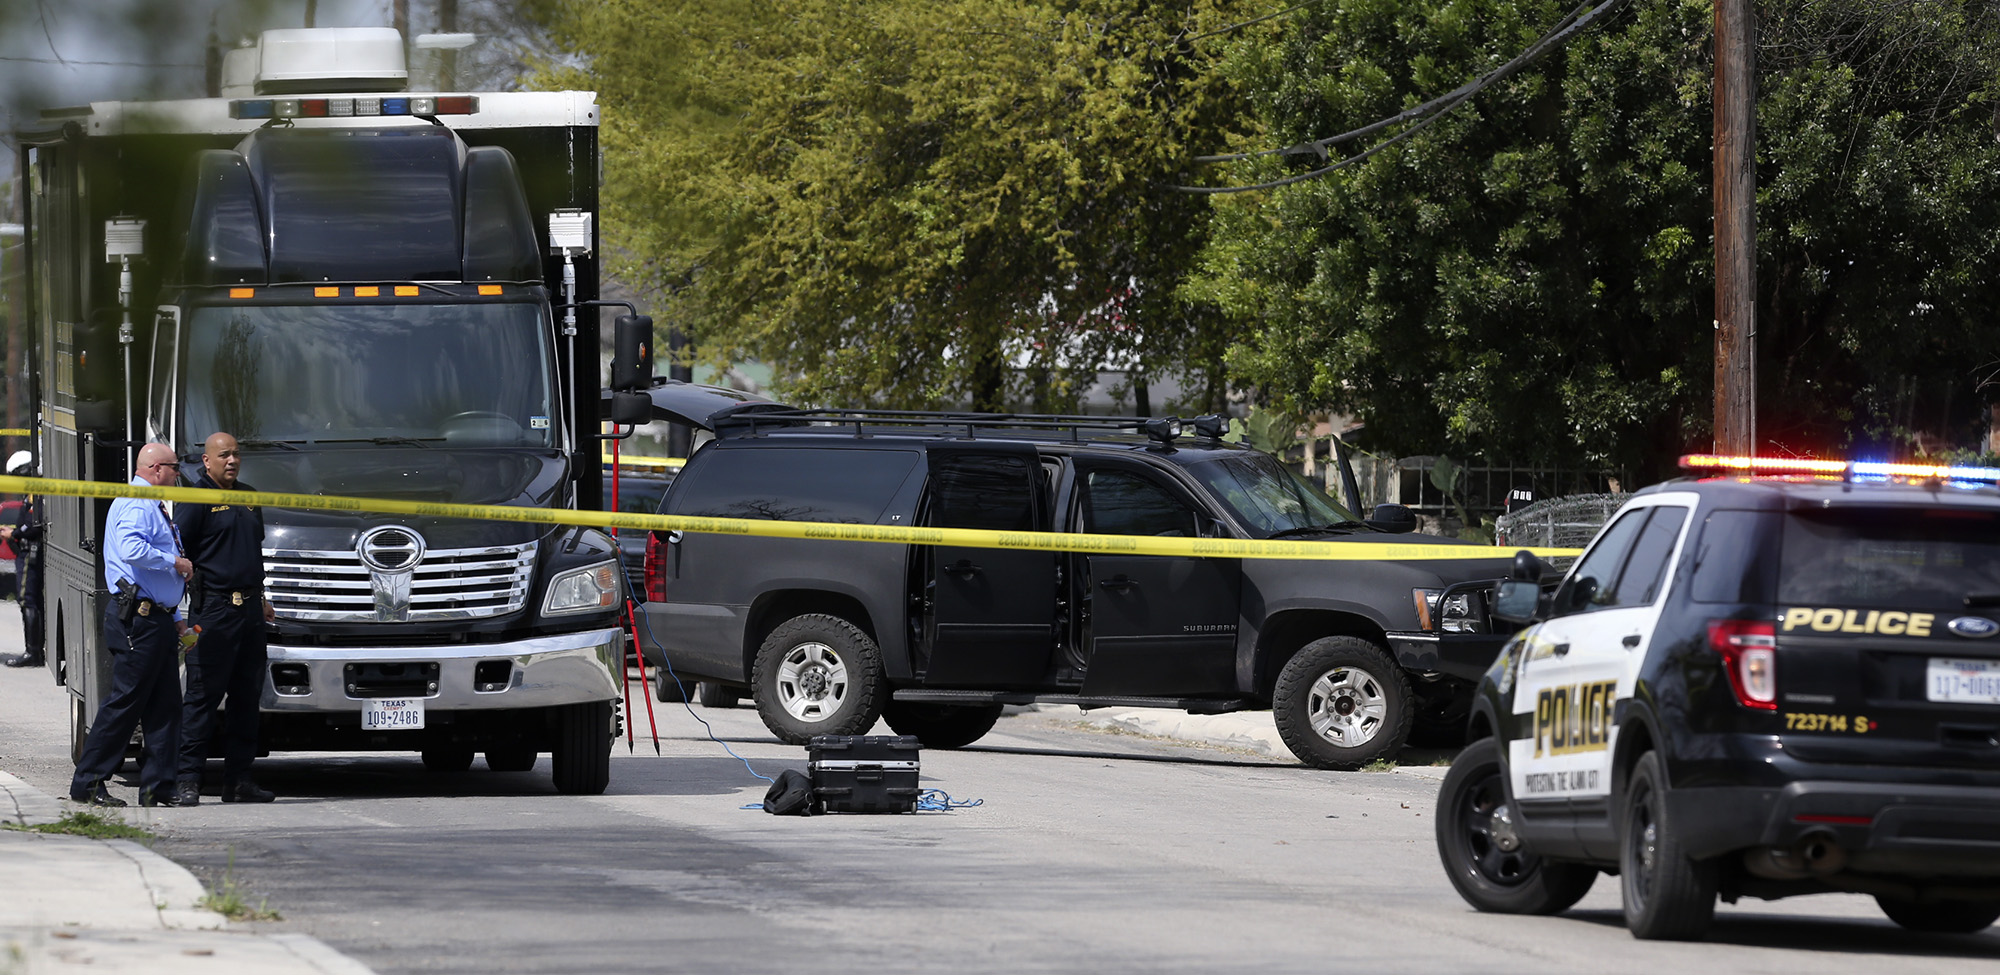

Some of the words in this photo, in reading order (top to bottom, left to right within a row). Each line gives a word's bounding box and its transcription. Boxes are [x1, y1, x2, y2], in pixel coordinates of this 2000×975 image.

[1183, 624, 1237, 632] SUBURBAN
[1783, 607, 1935, 637] POLICE
[1534, 680, 1617, 759] POLICE
[1785, 712, 1848, 732] 723714
